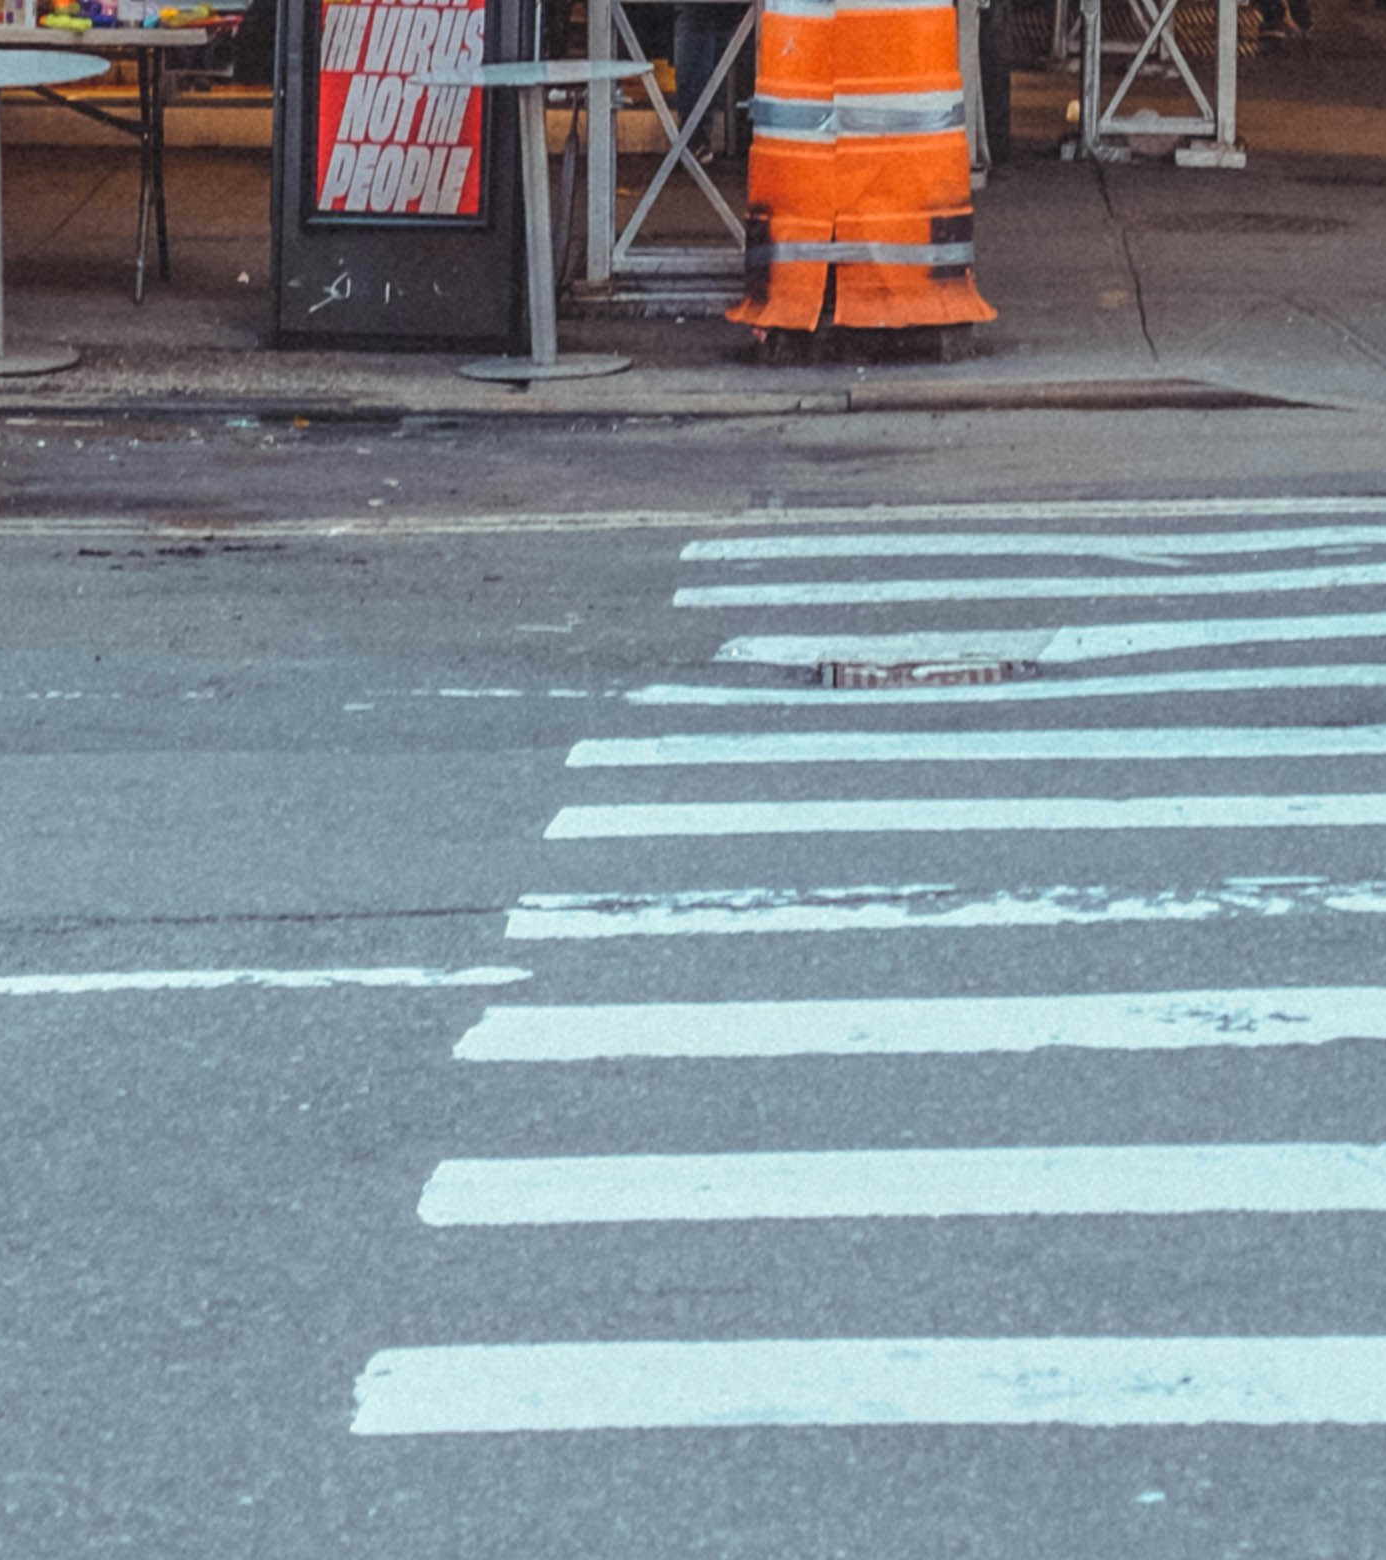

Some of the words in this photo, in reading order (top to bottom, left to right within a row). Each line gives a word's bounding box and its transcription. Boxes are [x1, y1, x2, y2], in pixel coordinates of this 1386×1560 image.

[321, 4, 371, 72] THE
[365, 7, 486, 83] VIRUS
[337, 73, 425, 142] NOT
[417, 85, 471, 144] THE
[317, 142, 473, 215] PEOPLE
